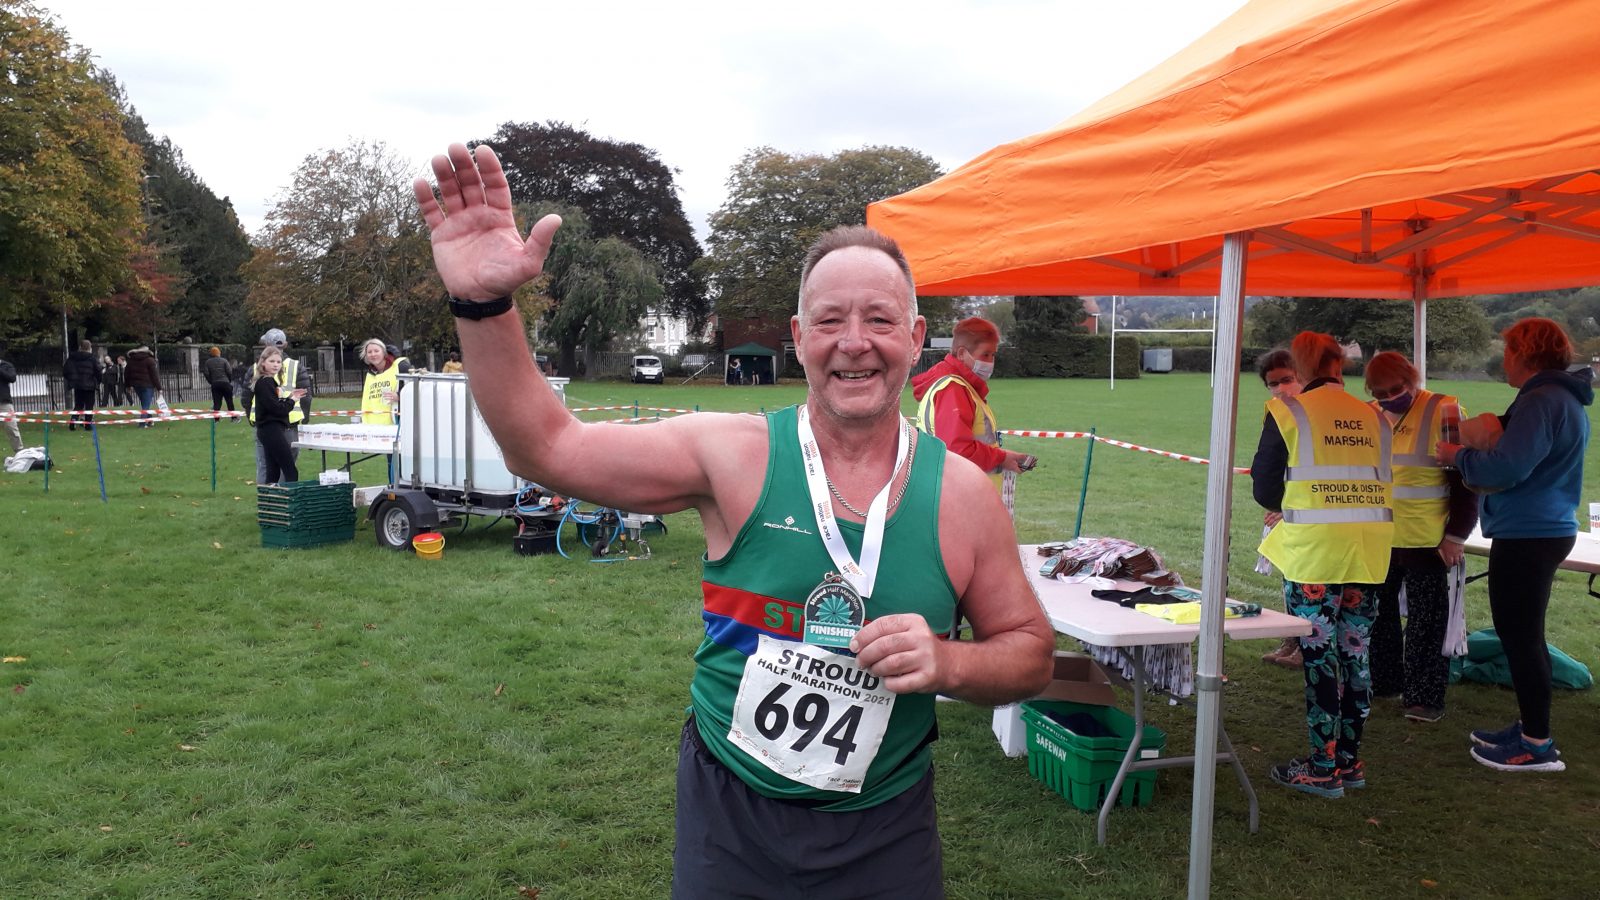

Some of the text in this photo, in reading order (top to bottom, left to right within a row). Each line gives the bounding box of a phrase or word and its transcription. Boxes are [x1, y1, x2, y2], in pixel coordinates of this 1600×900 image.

[1334, 419, 1364, 430] RACE
[1324, 435, 1375, 448] MARSHAL
[1311, 484, 1350, 493] STROUD
[1351, 484, 1359, 493] &
[1324, 495, 1386, 505] ATHLETIC CLUB
[763, 522, 813, 535] RONHILL
[823, 525, 832, 541] race
[810, 589, 826, 605] Stroud
[840, 588, 860, 611] Marathon
[763, 602, 805, 633] ST
[810, 624, 857, 637] FINISHER
[778, 649, 880, 691] STROUD
[757, 658, 891, 707] HALF MARATHON 2021
[754, 682, 864, 766] 694
[1036, 733, 1066, 762] SAFEWAY
